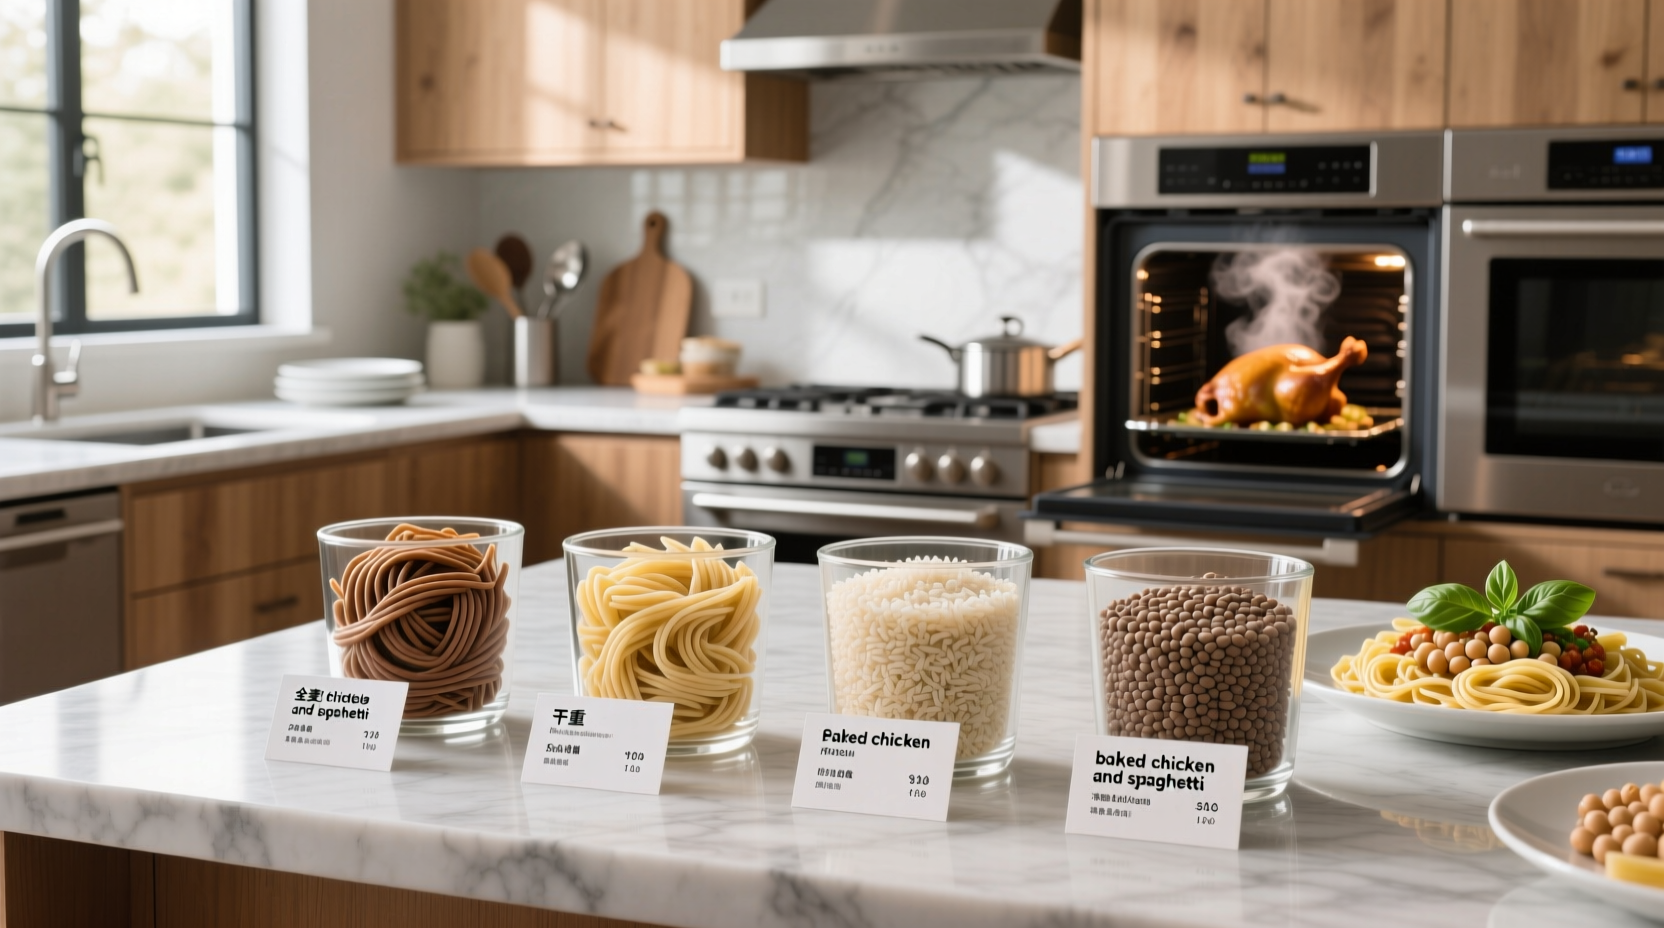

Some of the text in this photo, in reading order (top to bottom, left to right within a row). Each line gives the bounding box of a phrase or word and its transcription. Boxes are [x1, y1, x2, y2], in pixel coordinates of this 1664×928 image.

[291, 703, 315, 716] and
[552, 708, 587, 726] 干重
[871, 731, 931, 749] chicken
[1095, 750, 1215, 773] baked chicken
[1092, 770, 1205, 792] and spaghetti
